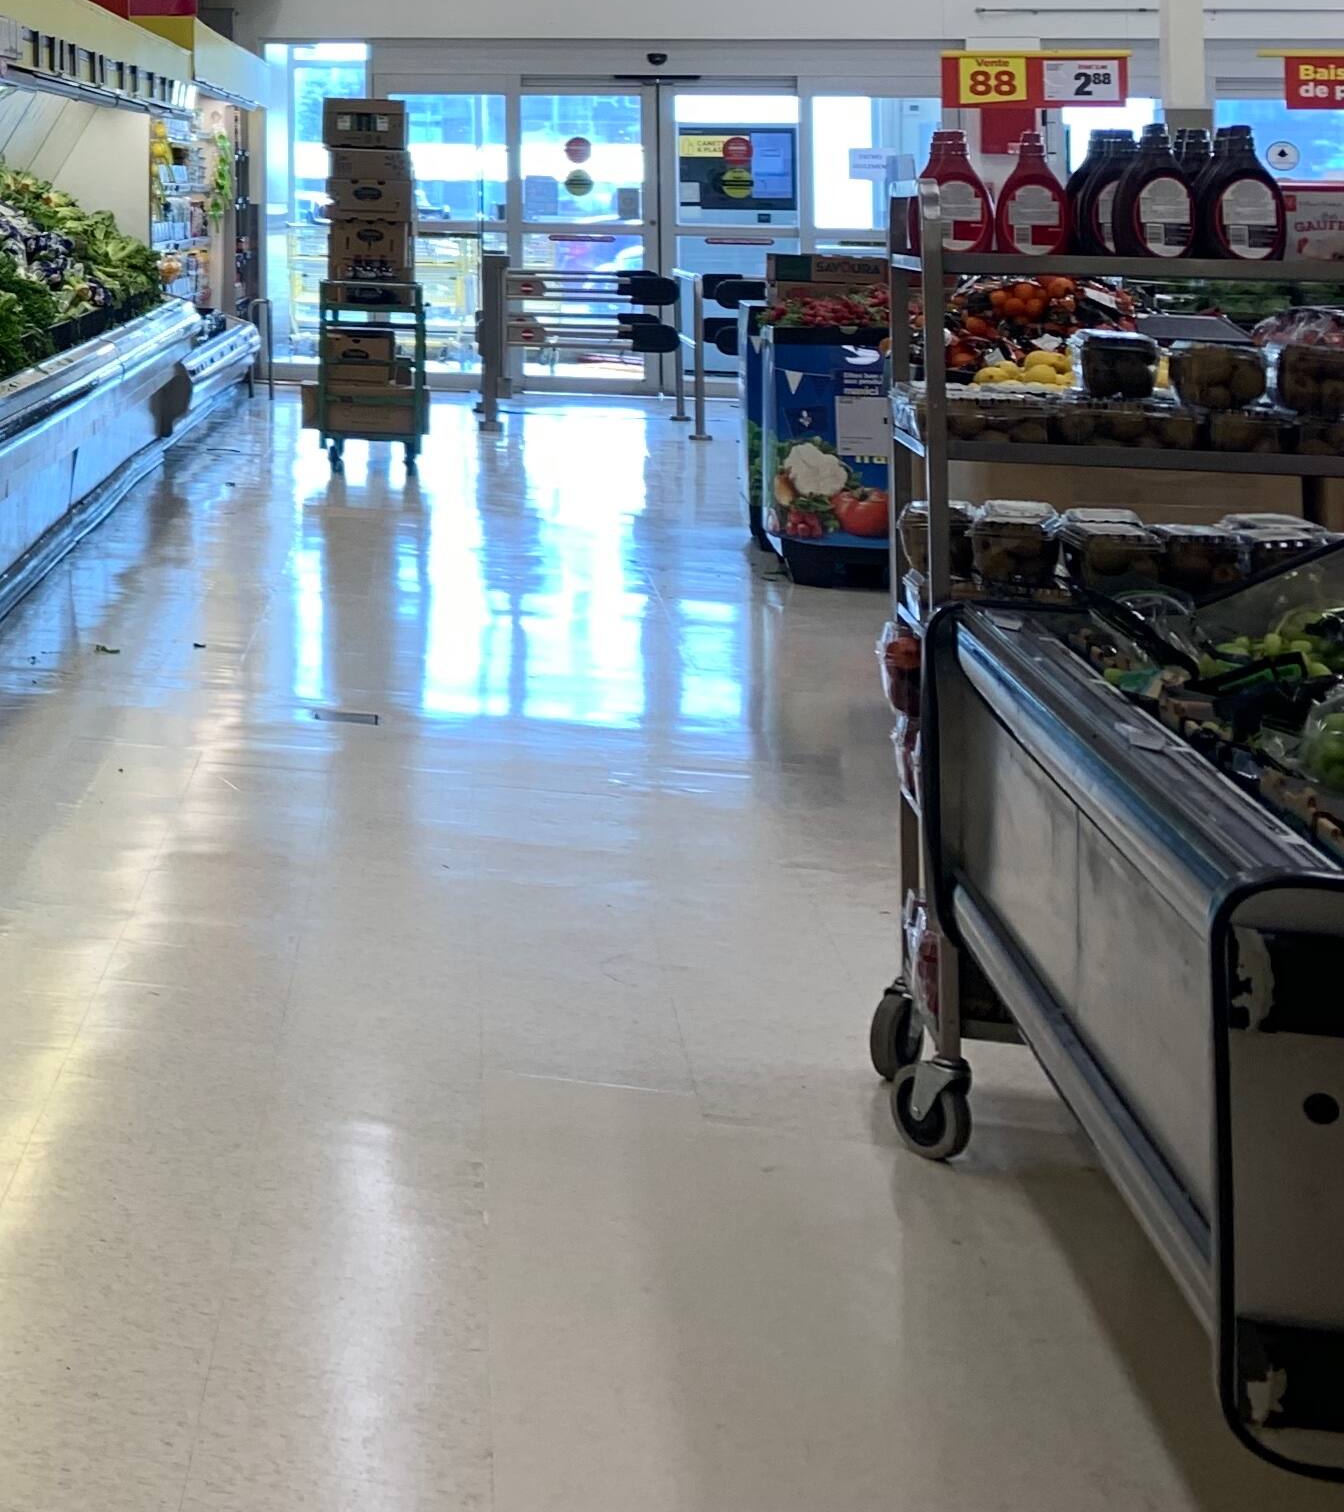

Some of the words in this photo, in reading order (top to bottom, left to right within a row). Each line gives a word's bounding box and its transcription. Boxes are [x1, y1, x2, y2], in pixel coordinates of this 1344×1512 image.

[975, 58, 1010, 68] Vente
[1298, 65, 1344, 80] Bais
[968, 70, 1017, 96] 88
[1299, 82, 1330, 99] de
[816, 262, 881, 275] SAVOURA
